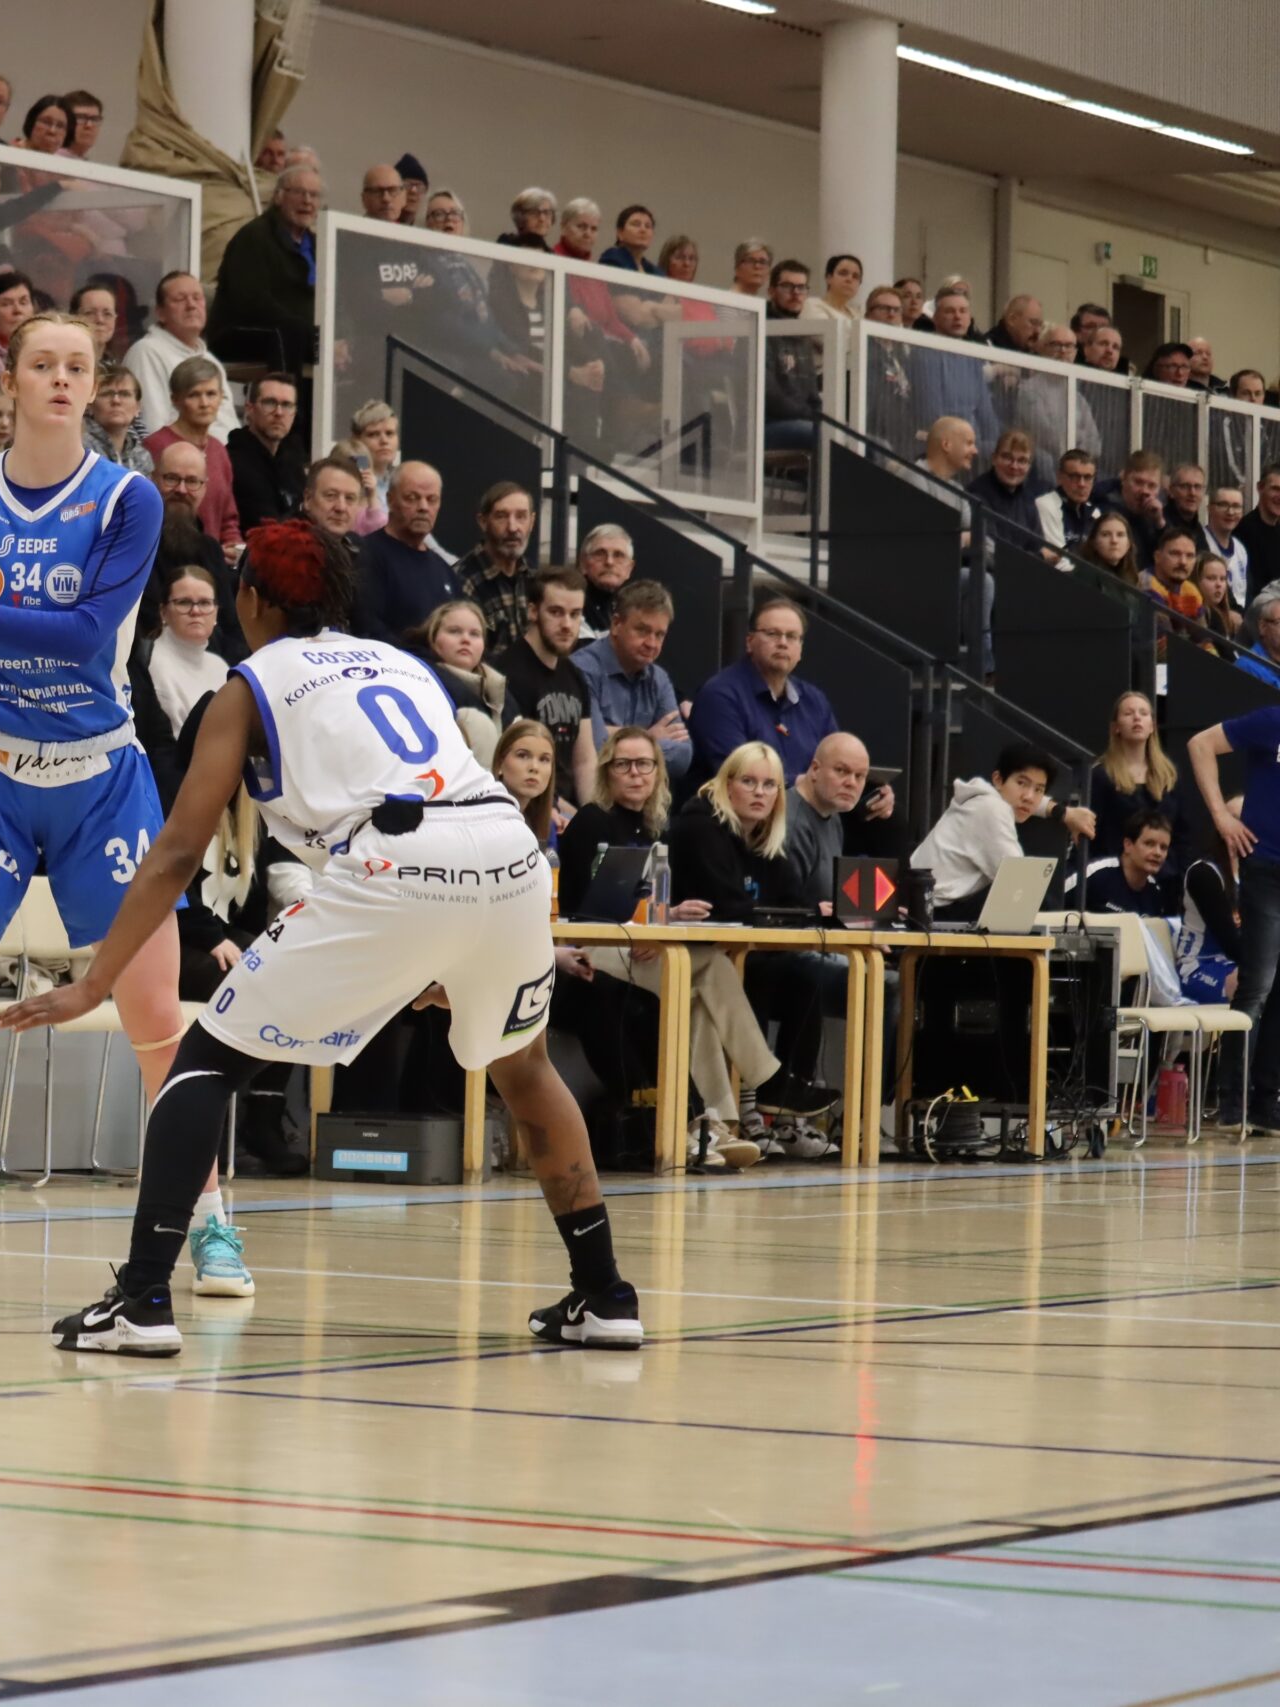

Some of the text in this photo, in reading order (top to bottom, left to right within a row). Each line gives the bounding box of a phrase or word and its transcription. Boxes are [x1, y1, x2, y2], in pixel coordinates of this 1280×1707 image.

[17, 537, 58, 554] EEPEE
[10, 562, 41, 592] 34
[302, 650, 382, 665] COSBY
[284, 673, 341, 707] Kotkan
